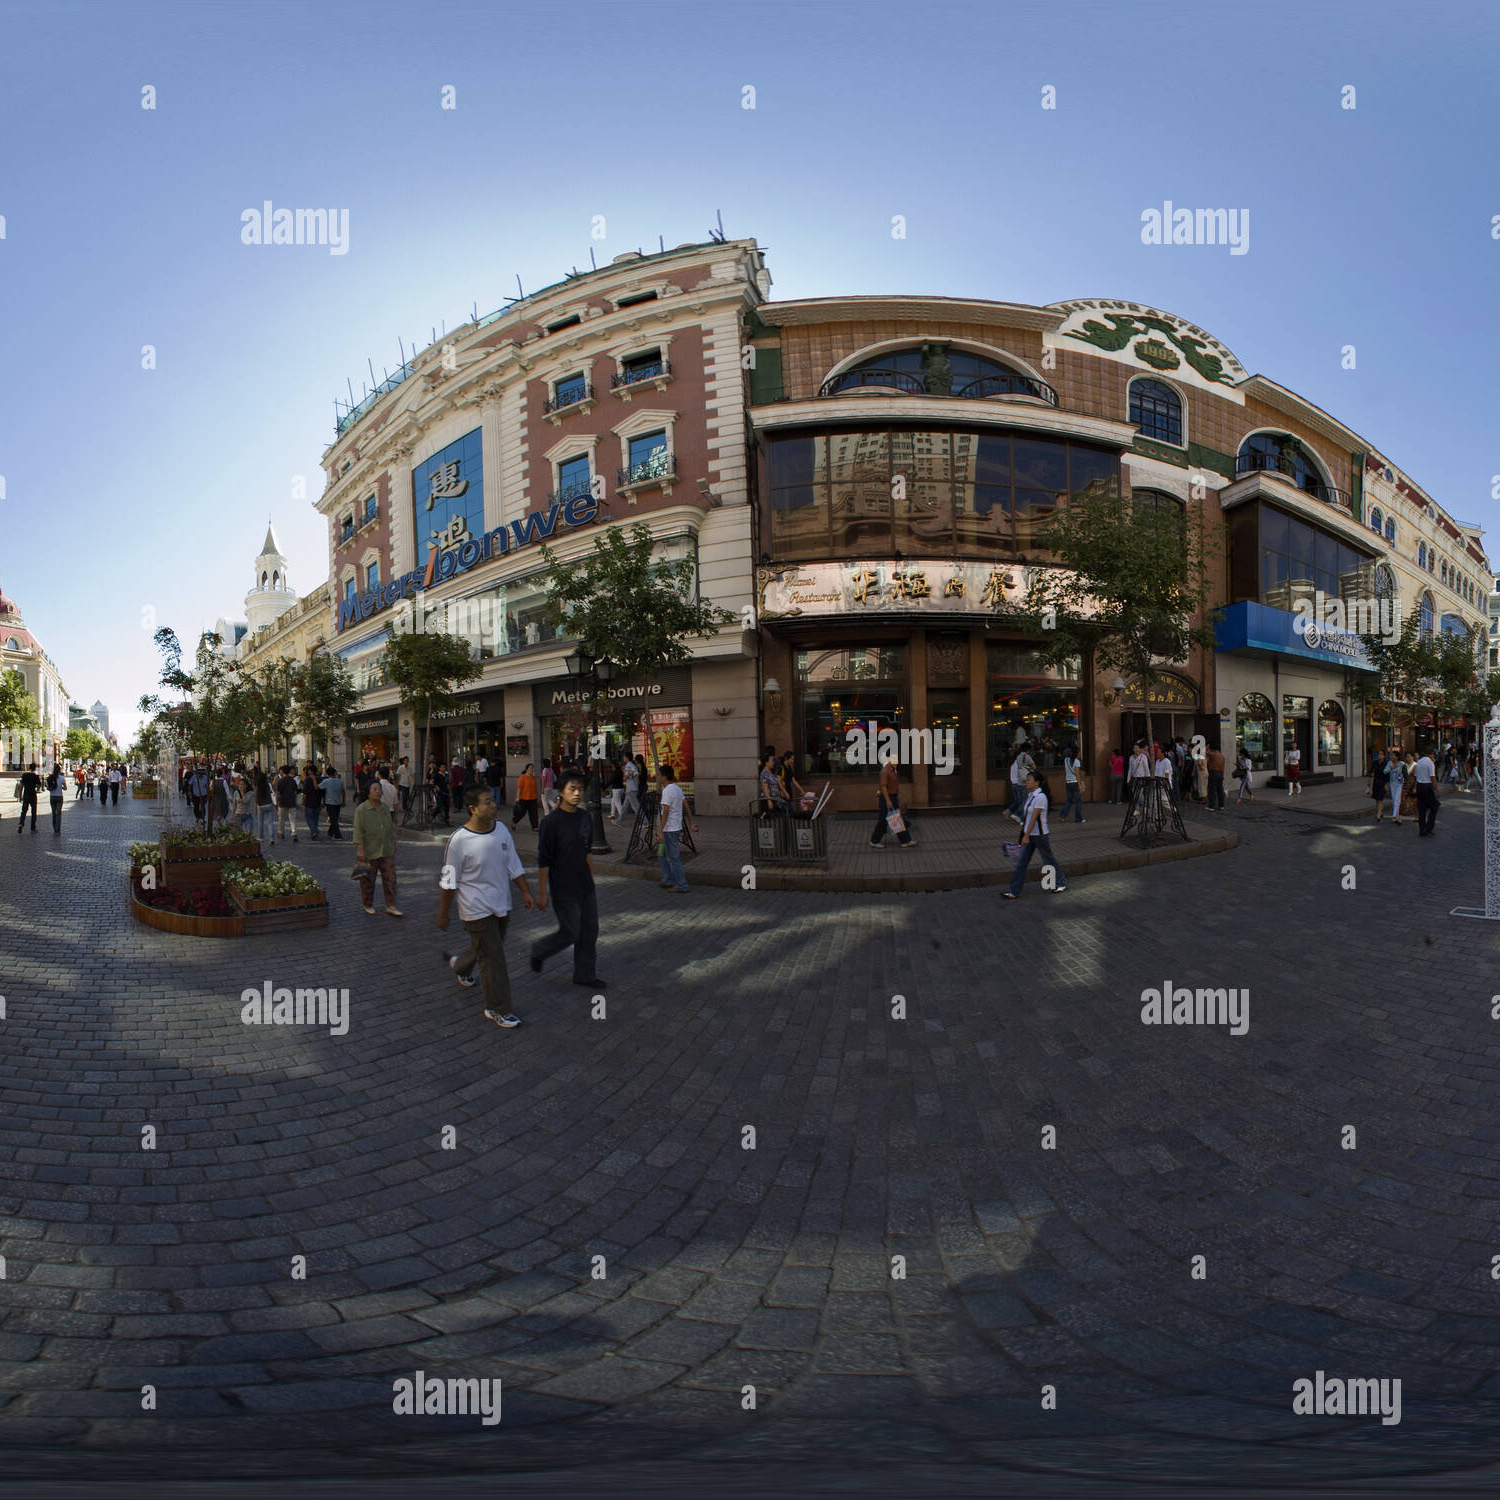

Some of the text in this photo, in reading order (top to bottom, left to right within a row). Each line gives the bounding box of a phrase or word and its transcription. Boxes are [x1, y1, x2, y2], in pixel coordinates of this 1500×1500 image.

[1058, 300, 1189, 328] ESTAURANT
[1142, 344, 1178, 363] 1992
[852, 568, 1046, 606] 华梅西餐
